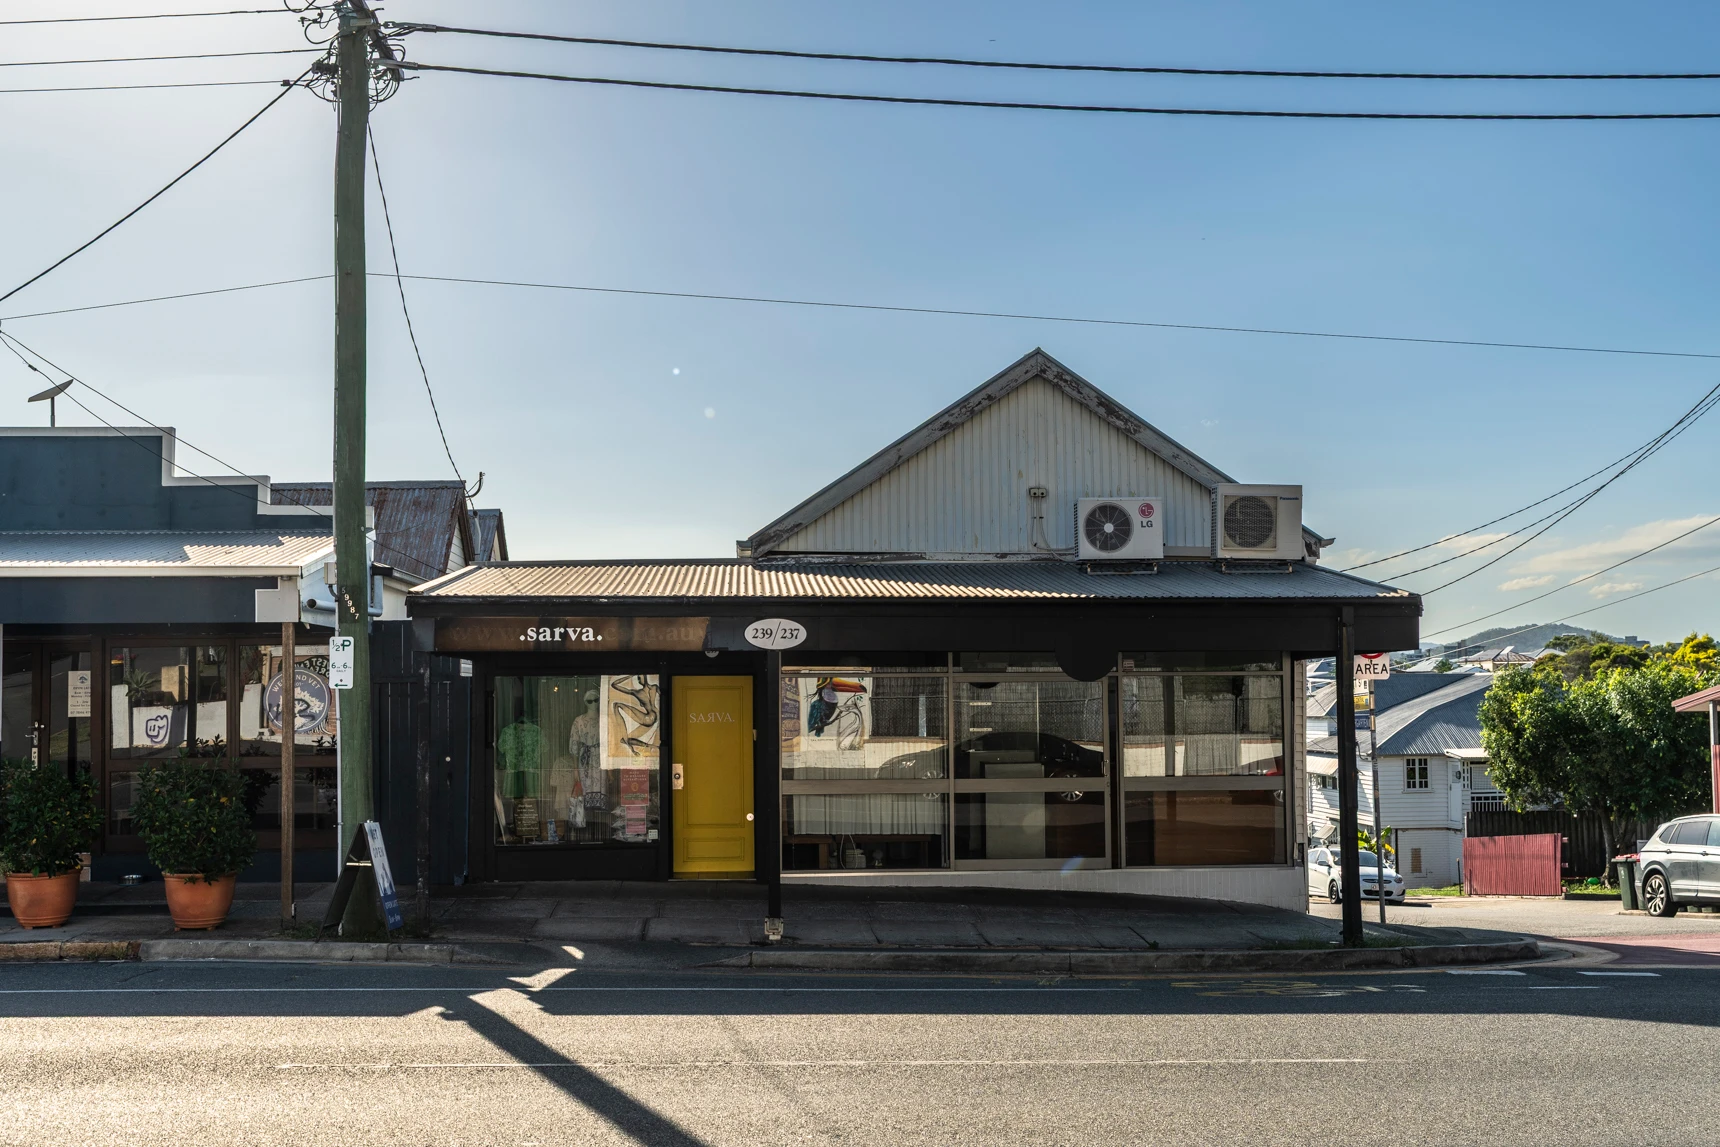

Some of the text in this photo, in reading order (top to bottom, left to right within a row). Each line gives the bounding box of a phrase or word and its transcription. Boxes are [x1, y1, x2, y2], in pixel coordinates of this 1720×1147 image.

[1140, 520, 1153, 528] LG
[1355, 663, 1389, 675] AREA
[308, 678, 320, 689] VET
